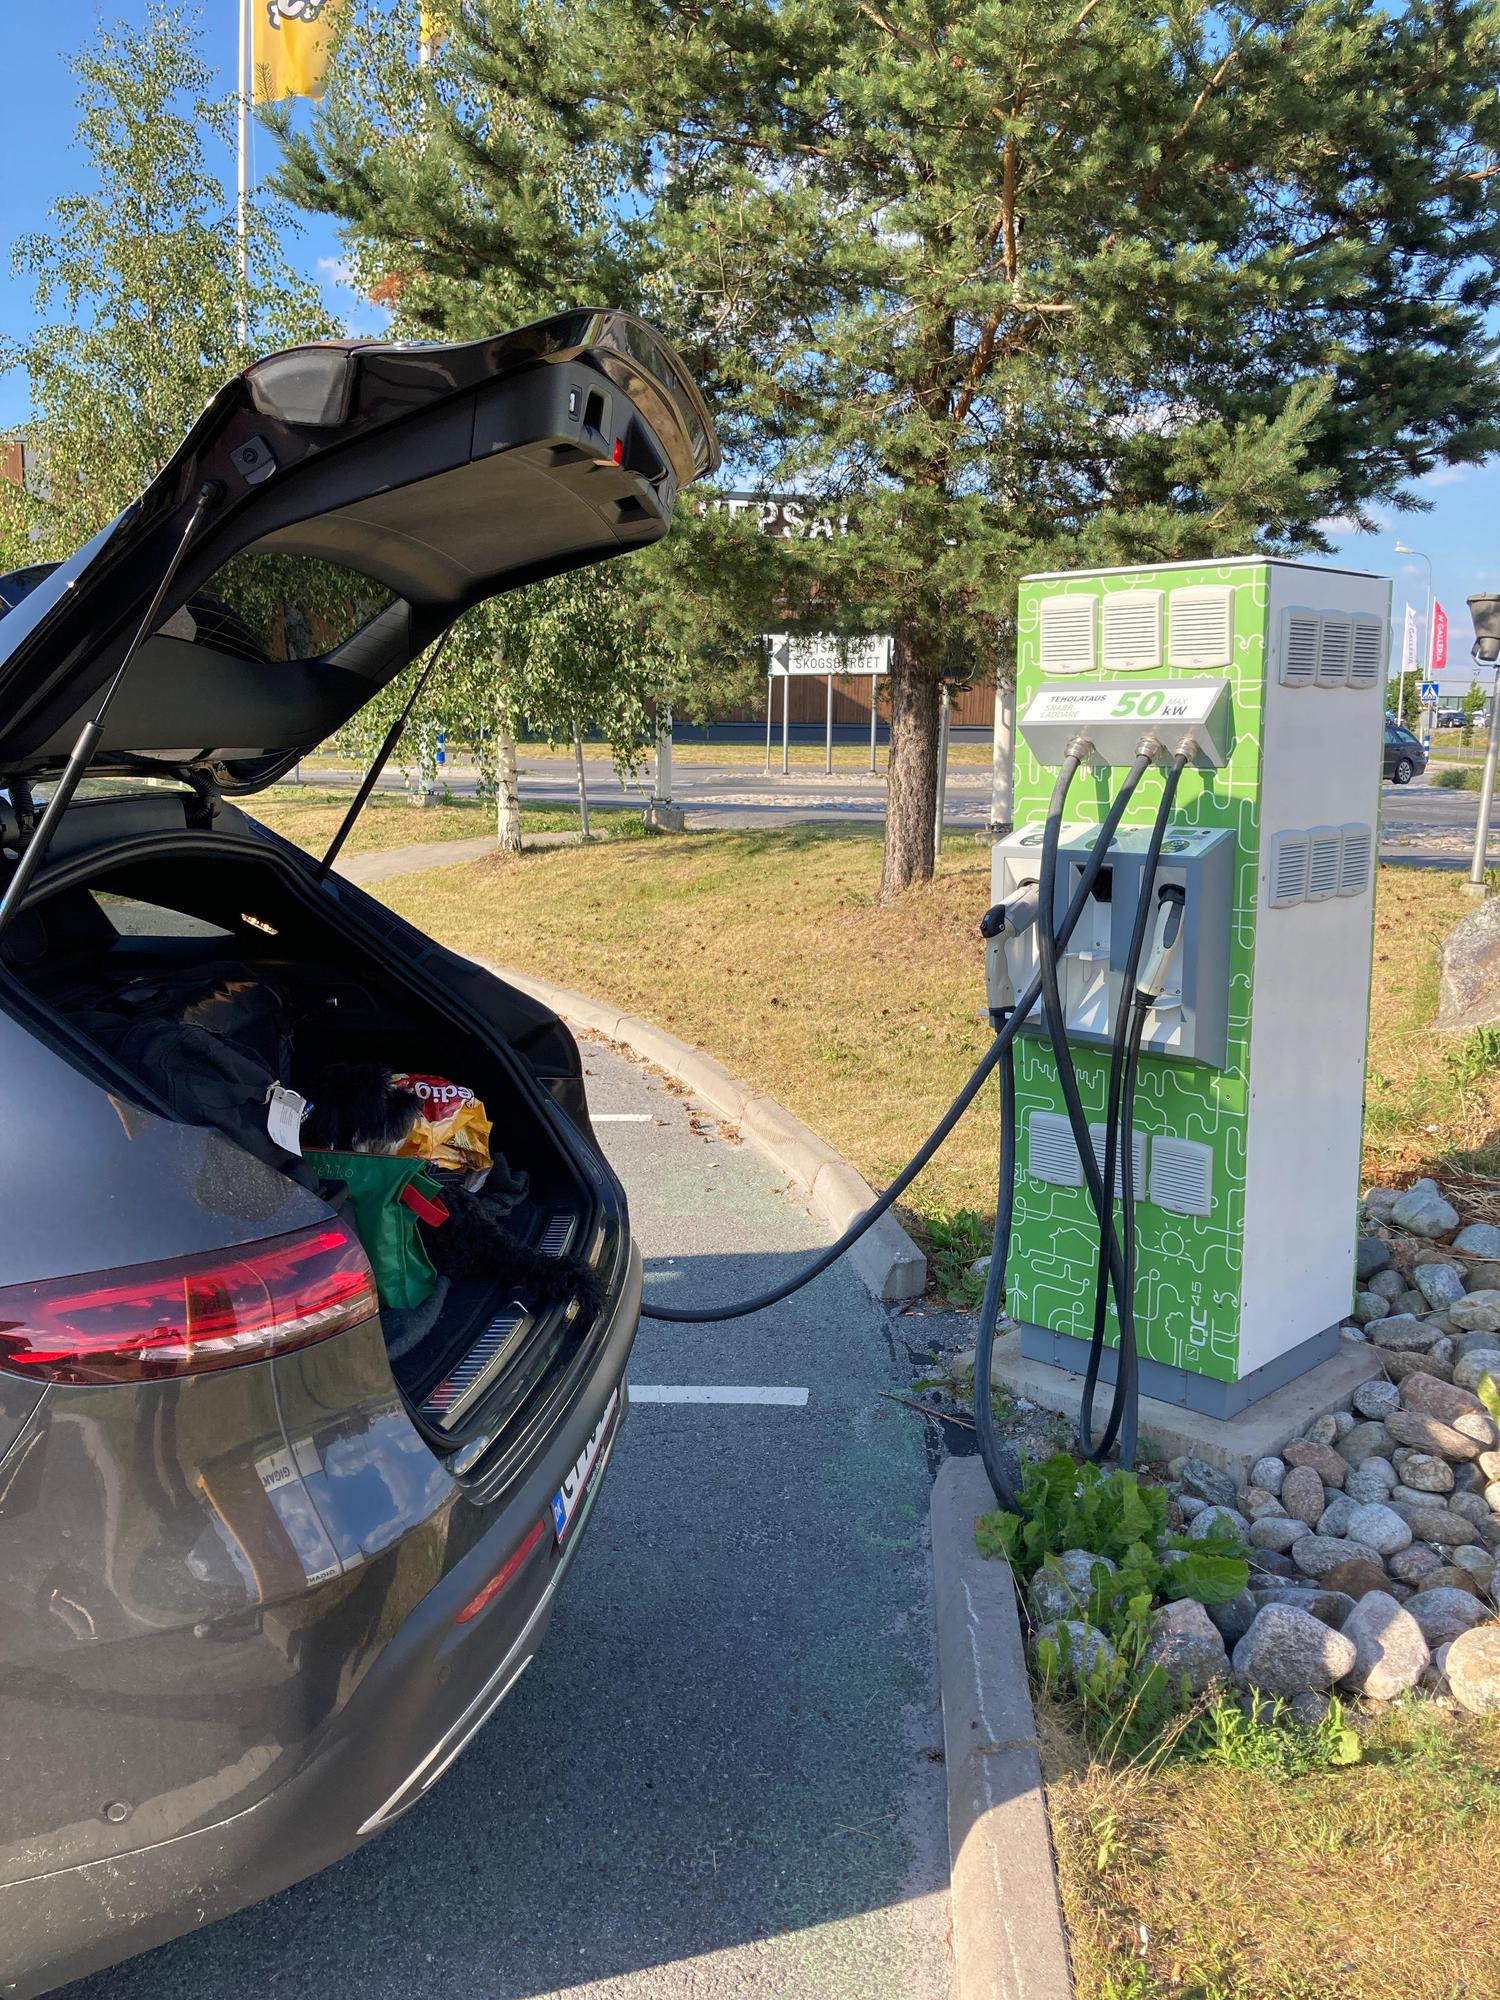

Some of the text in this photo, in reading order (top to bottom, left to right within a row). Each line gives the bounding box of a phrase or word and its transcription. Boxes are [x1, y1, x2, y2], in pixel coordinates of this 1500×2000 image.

[795, 656, 880, 669] SKOGSBRGET
[1050, 695, 1108, 703] TEHOLATAUS
[1110, 691, 1188, 717] 50 kW
